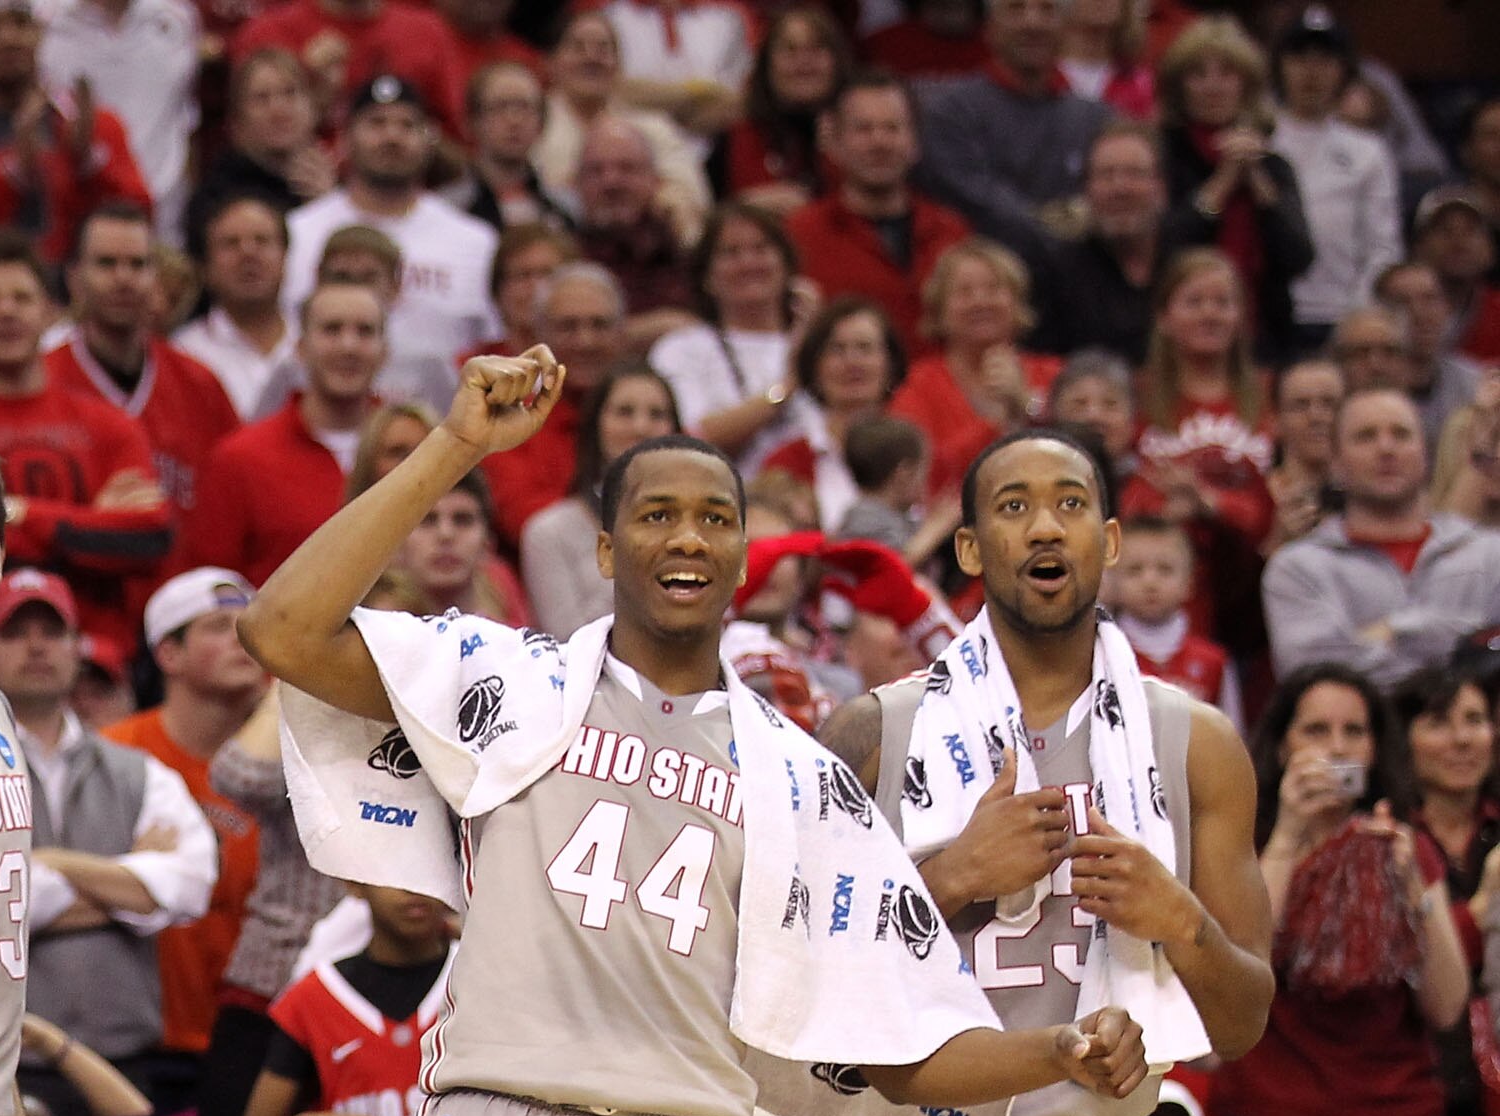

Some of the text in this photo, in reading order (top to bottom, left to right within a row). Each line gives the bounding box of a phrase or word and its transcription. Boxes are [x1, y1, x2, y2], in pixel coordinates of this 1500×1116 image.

[561, 723, 648, 787] HIO
[941, 732, 977, 790] NCAA
[359, 799, 419, 828] NCAA
[545, 798, 718, 958] 44
[828, 873, 856, 937] NCAA
